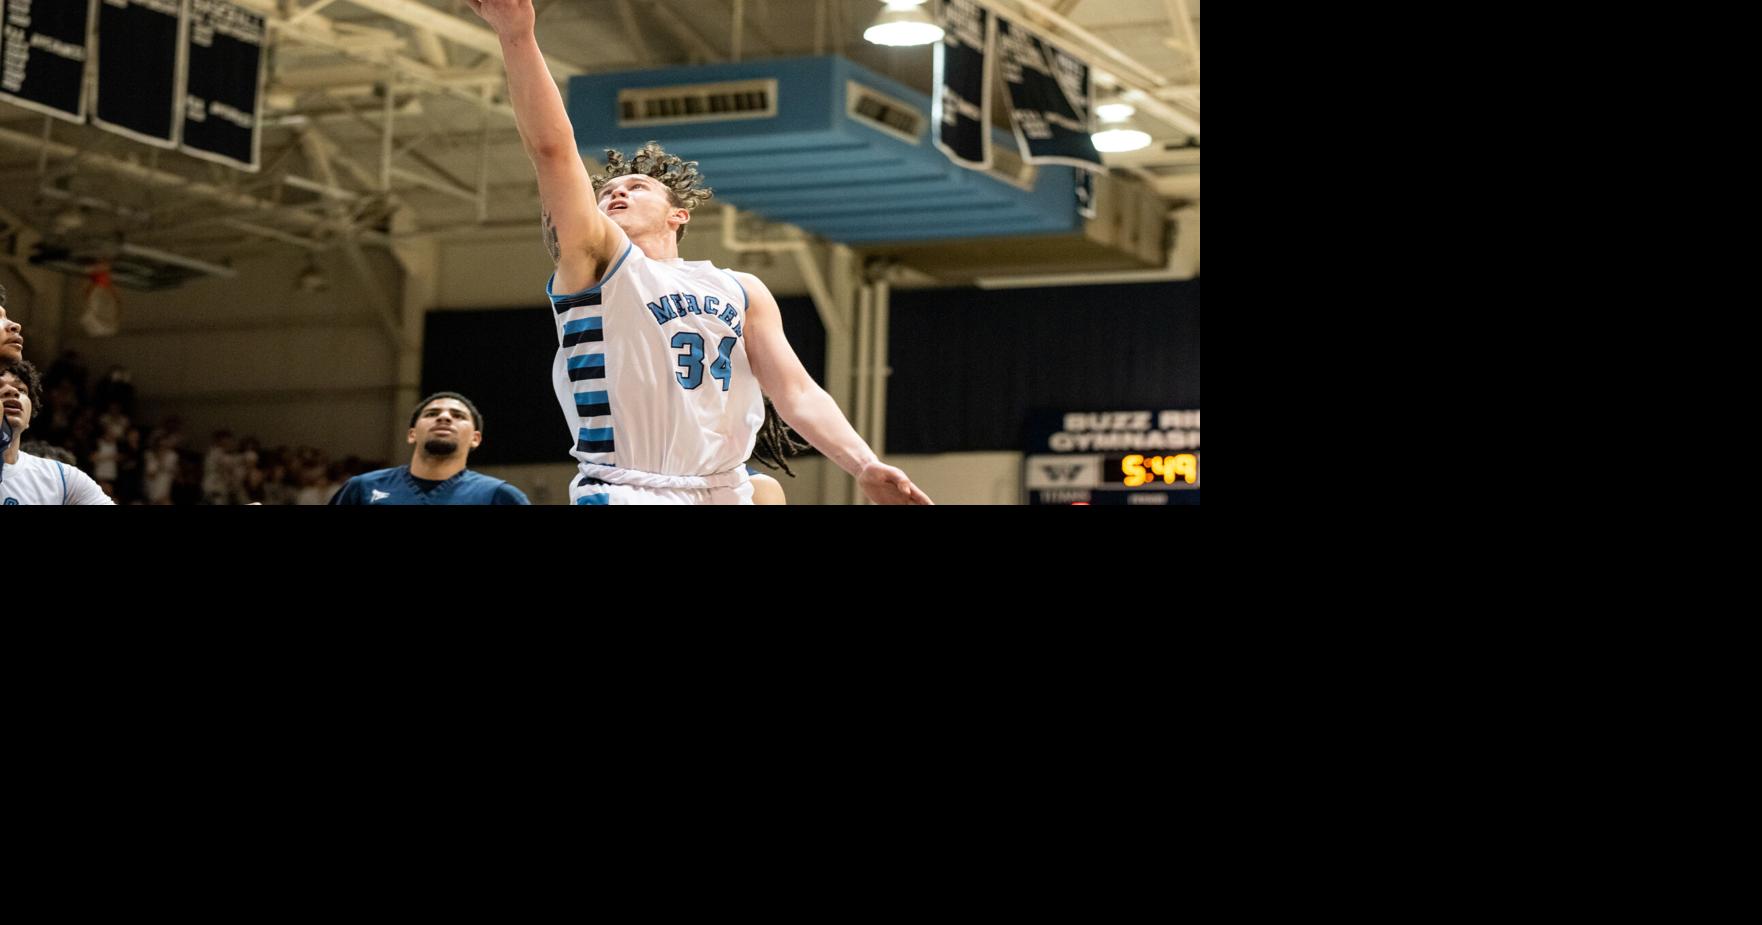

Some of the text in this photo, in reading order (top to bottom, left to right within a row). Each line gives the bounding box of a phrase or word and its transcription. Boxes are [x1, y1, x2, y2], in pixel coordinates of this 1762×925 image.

[671, 332, 738, 391] 34
[1064, 410, 1200, 431] BUZZ RI
[1121, 453, 1197, 487] 5:49
